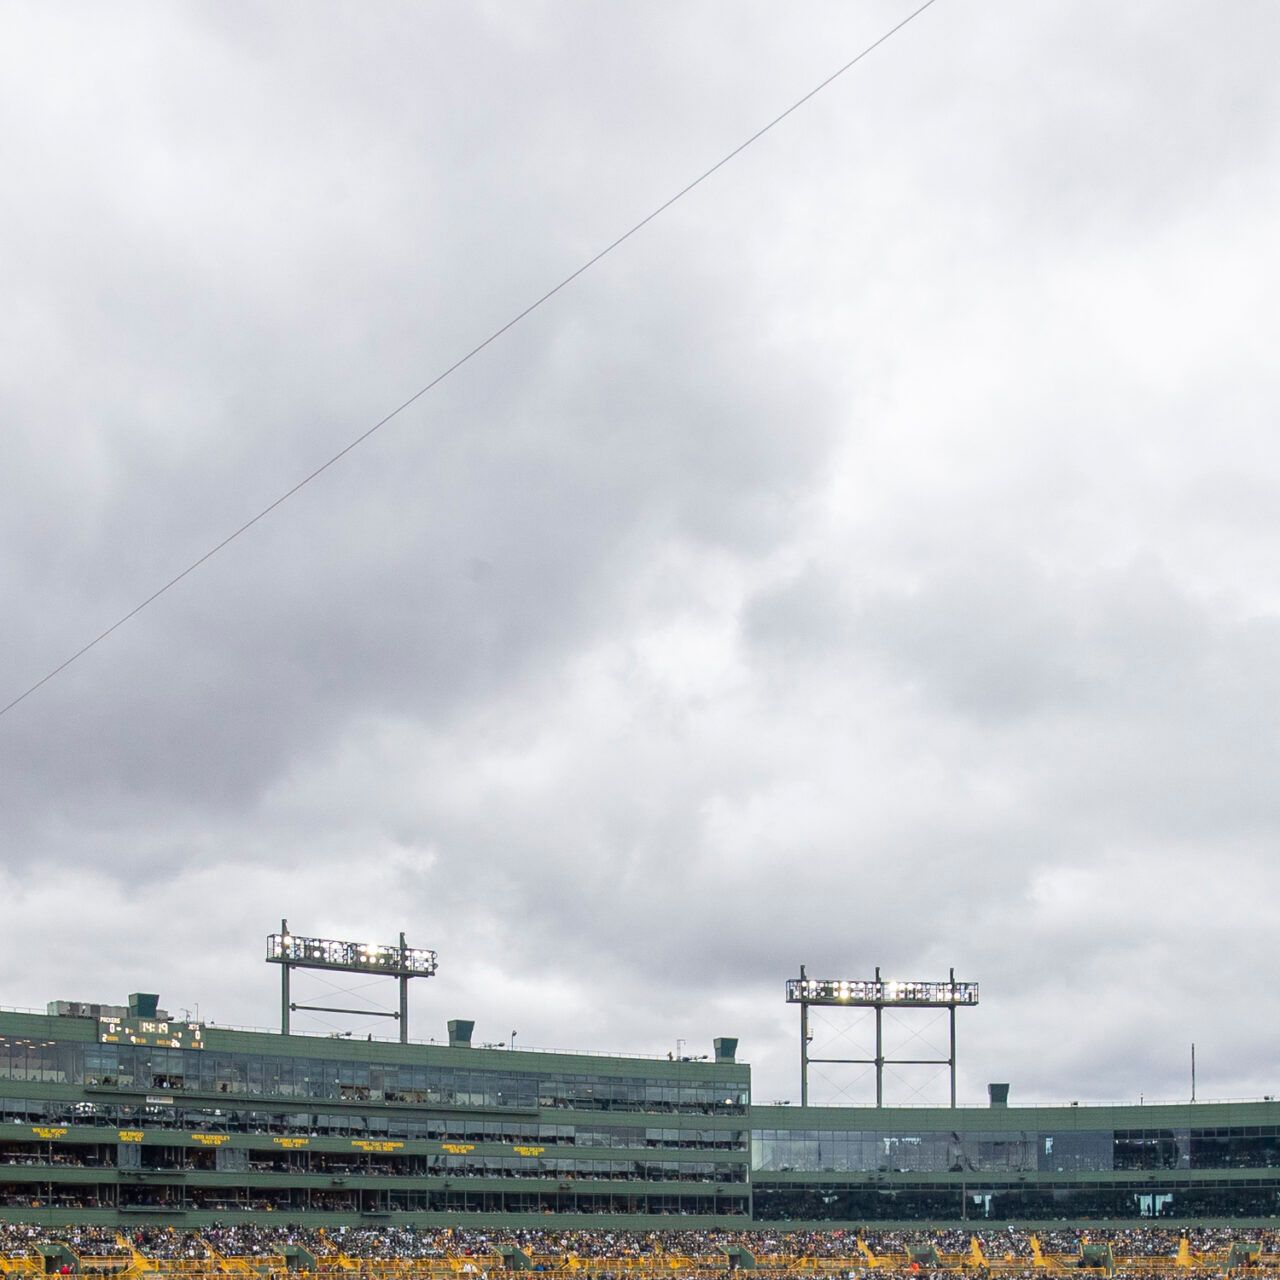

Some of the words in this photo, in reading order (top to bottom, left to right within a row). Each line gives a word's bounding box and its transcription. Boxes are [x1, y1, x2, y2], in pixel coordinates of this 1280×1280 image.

[100, 1016, 120, 1024] PACKERS
[109, 1023, 115, 1033] 0
[142, 1022, 169, 1034] 14:19
